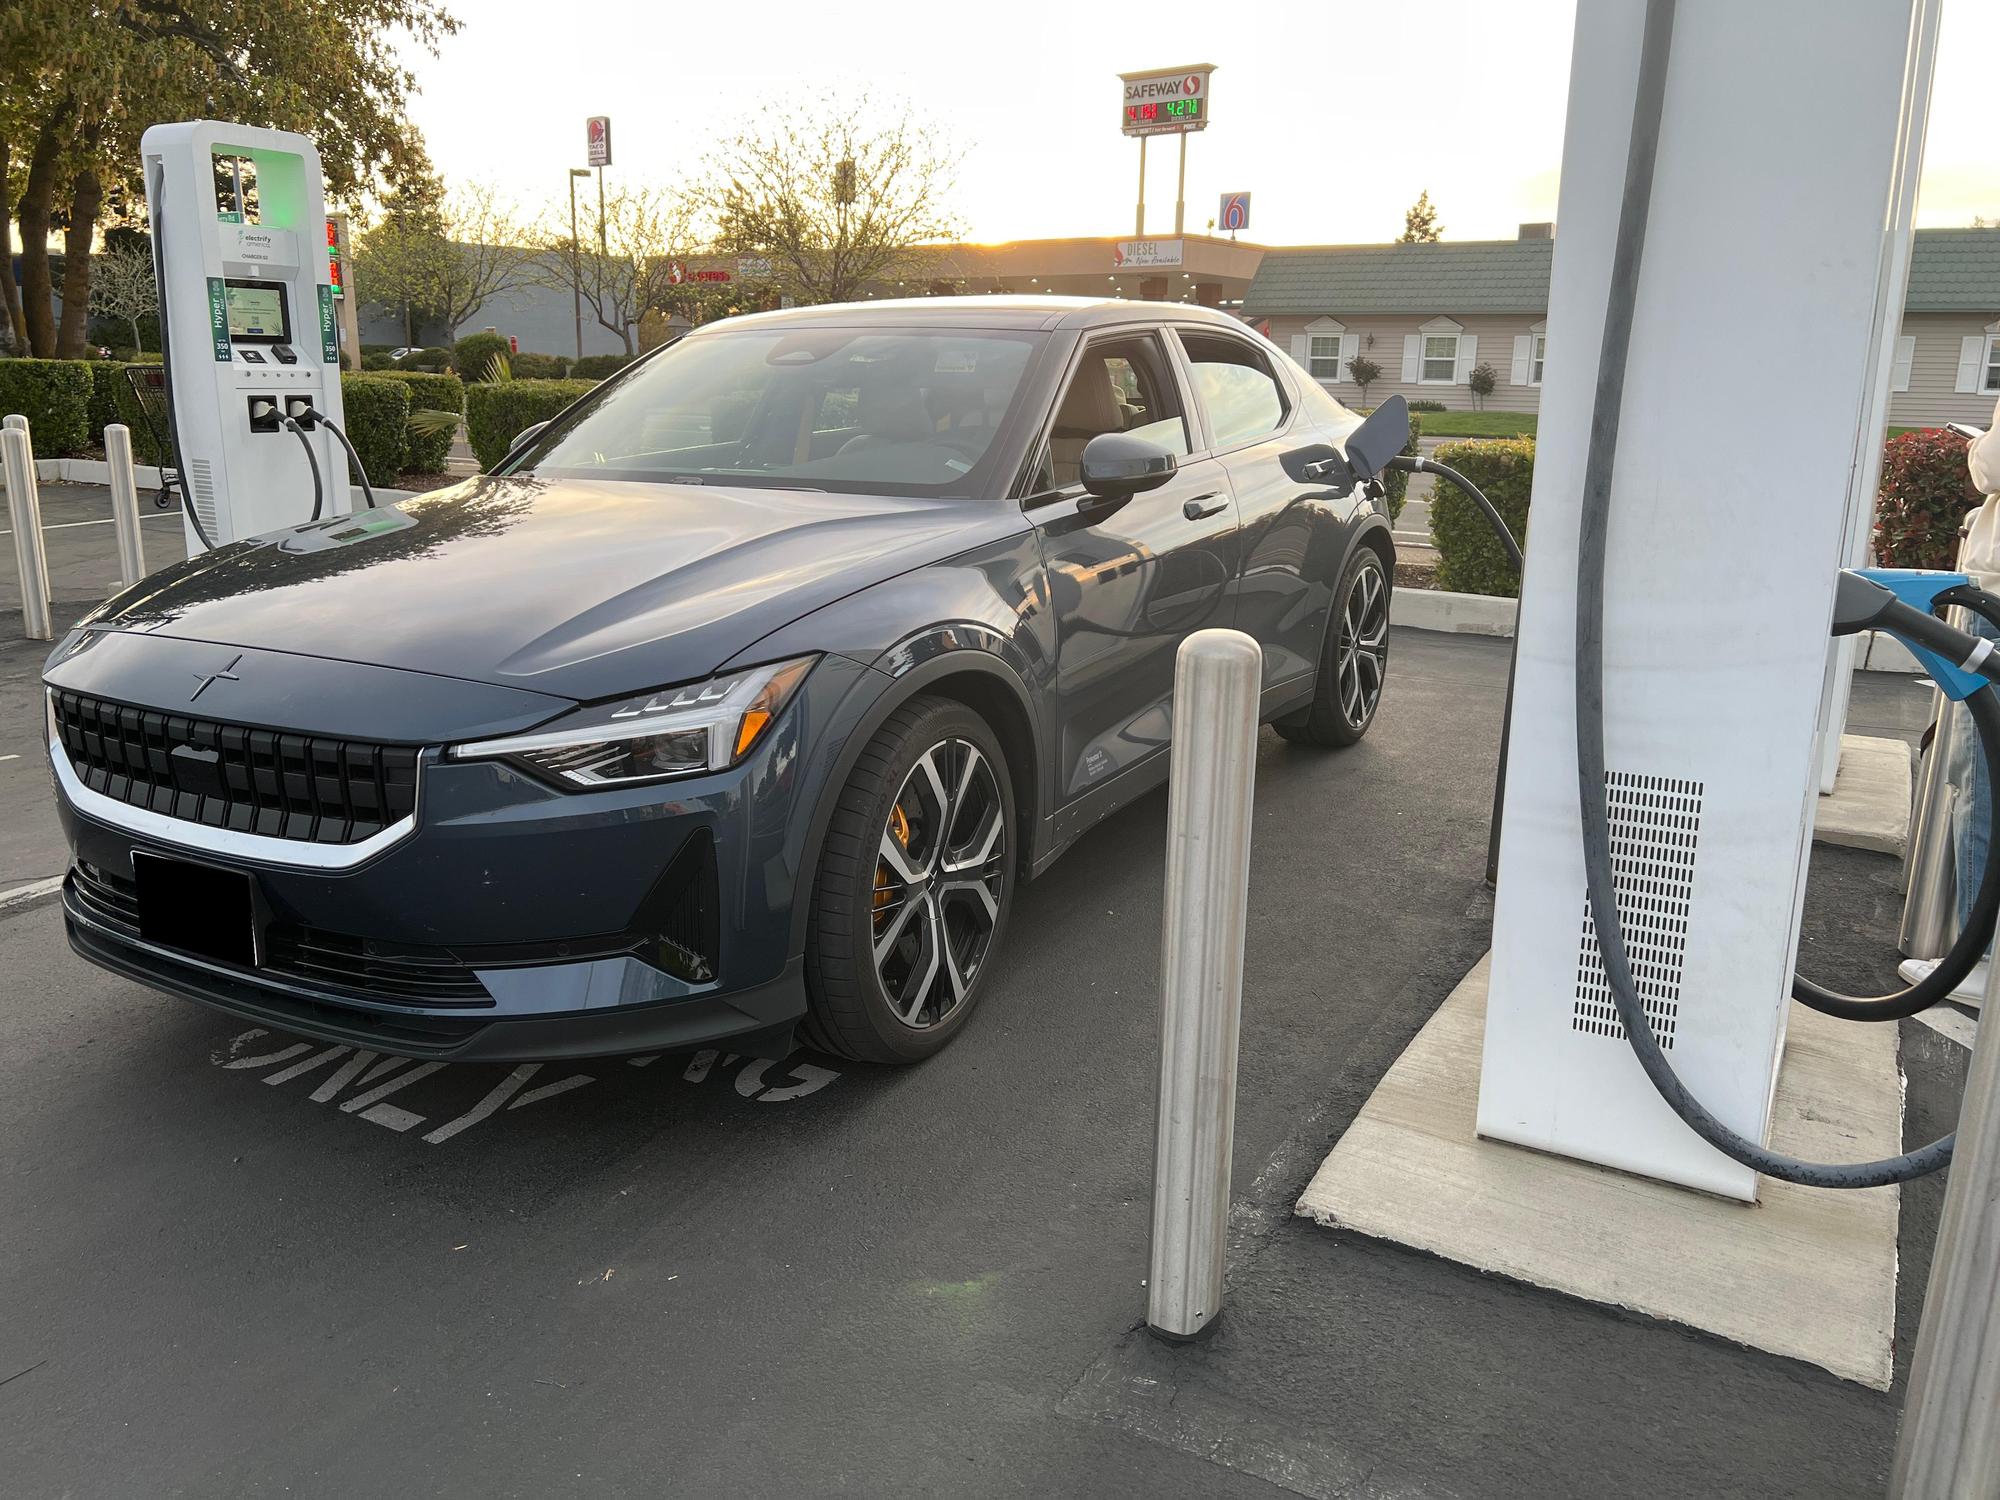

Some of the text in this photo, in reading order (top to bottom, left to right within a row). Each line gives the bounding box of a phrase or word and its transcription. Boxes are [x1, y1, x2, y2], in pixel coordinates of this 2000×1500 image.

[1126, 80, 1182, 99] SAFEWAY
[1223, 193, 1245, 230] 6
[245, 235, 272, 243] electrify
[1127, 242, 1158, 256] DIESEL
[213, 298, 223, 328] Hyper
[322, 303, 332, 332] Hyper
[216, 342, 229, 350] 350
